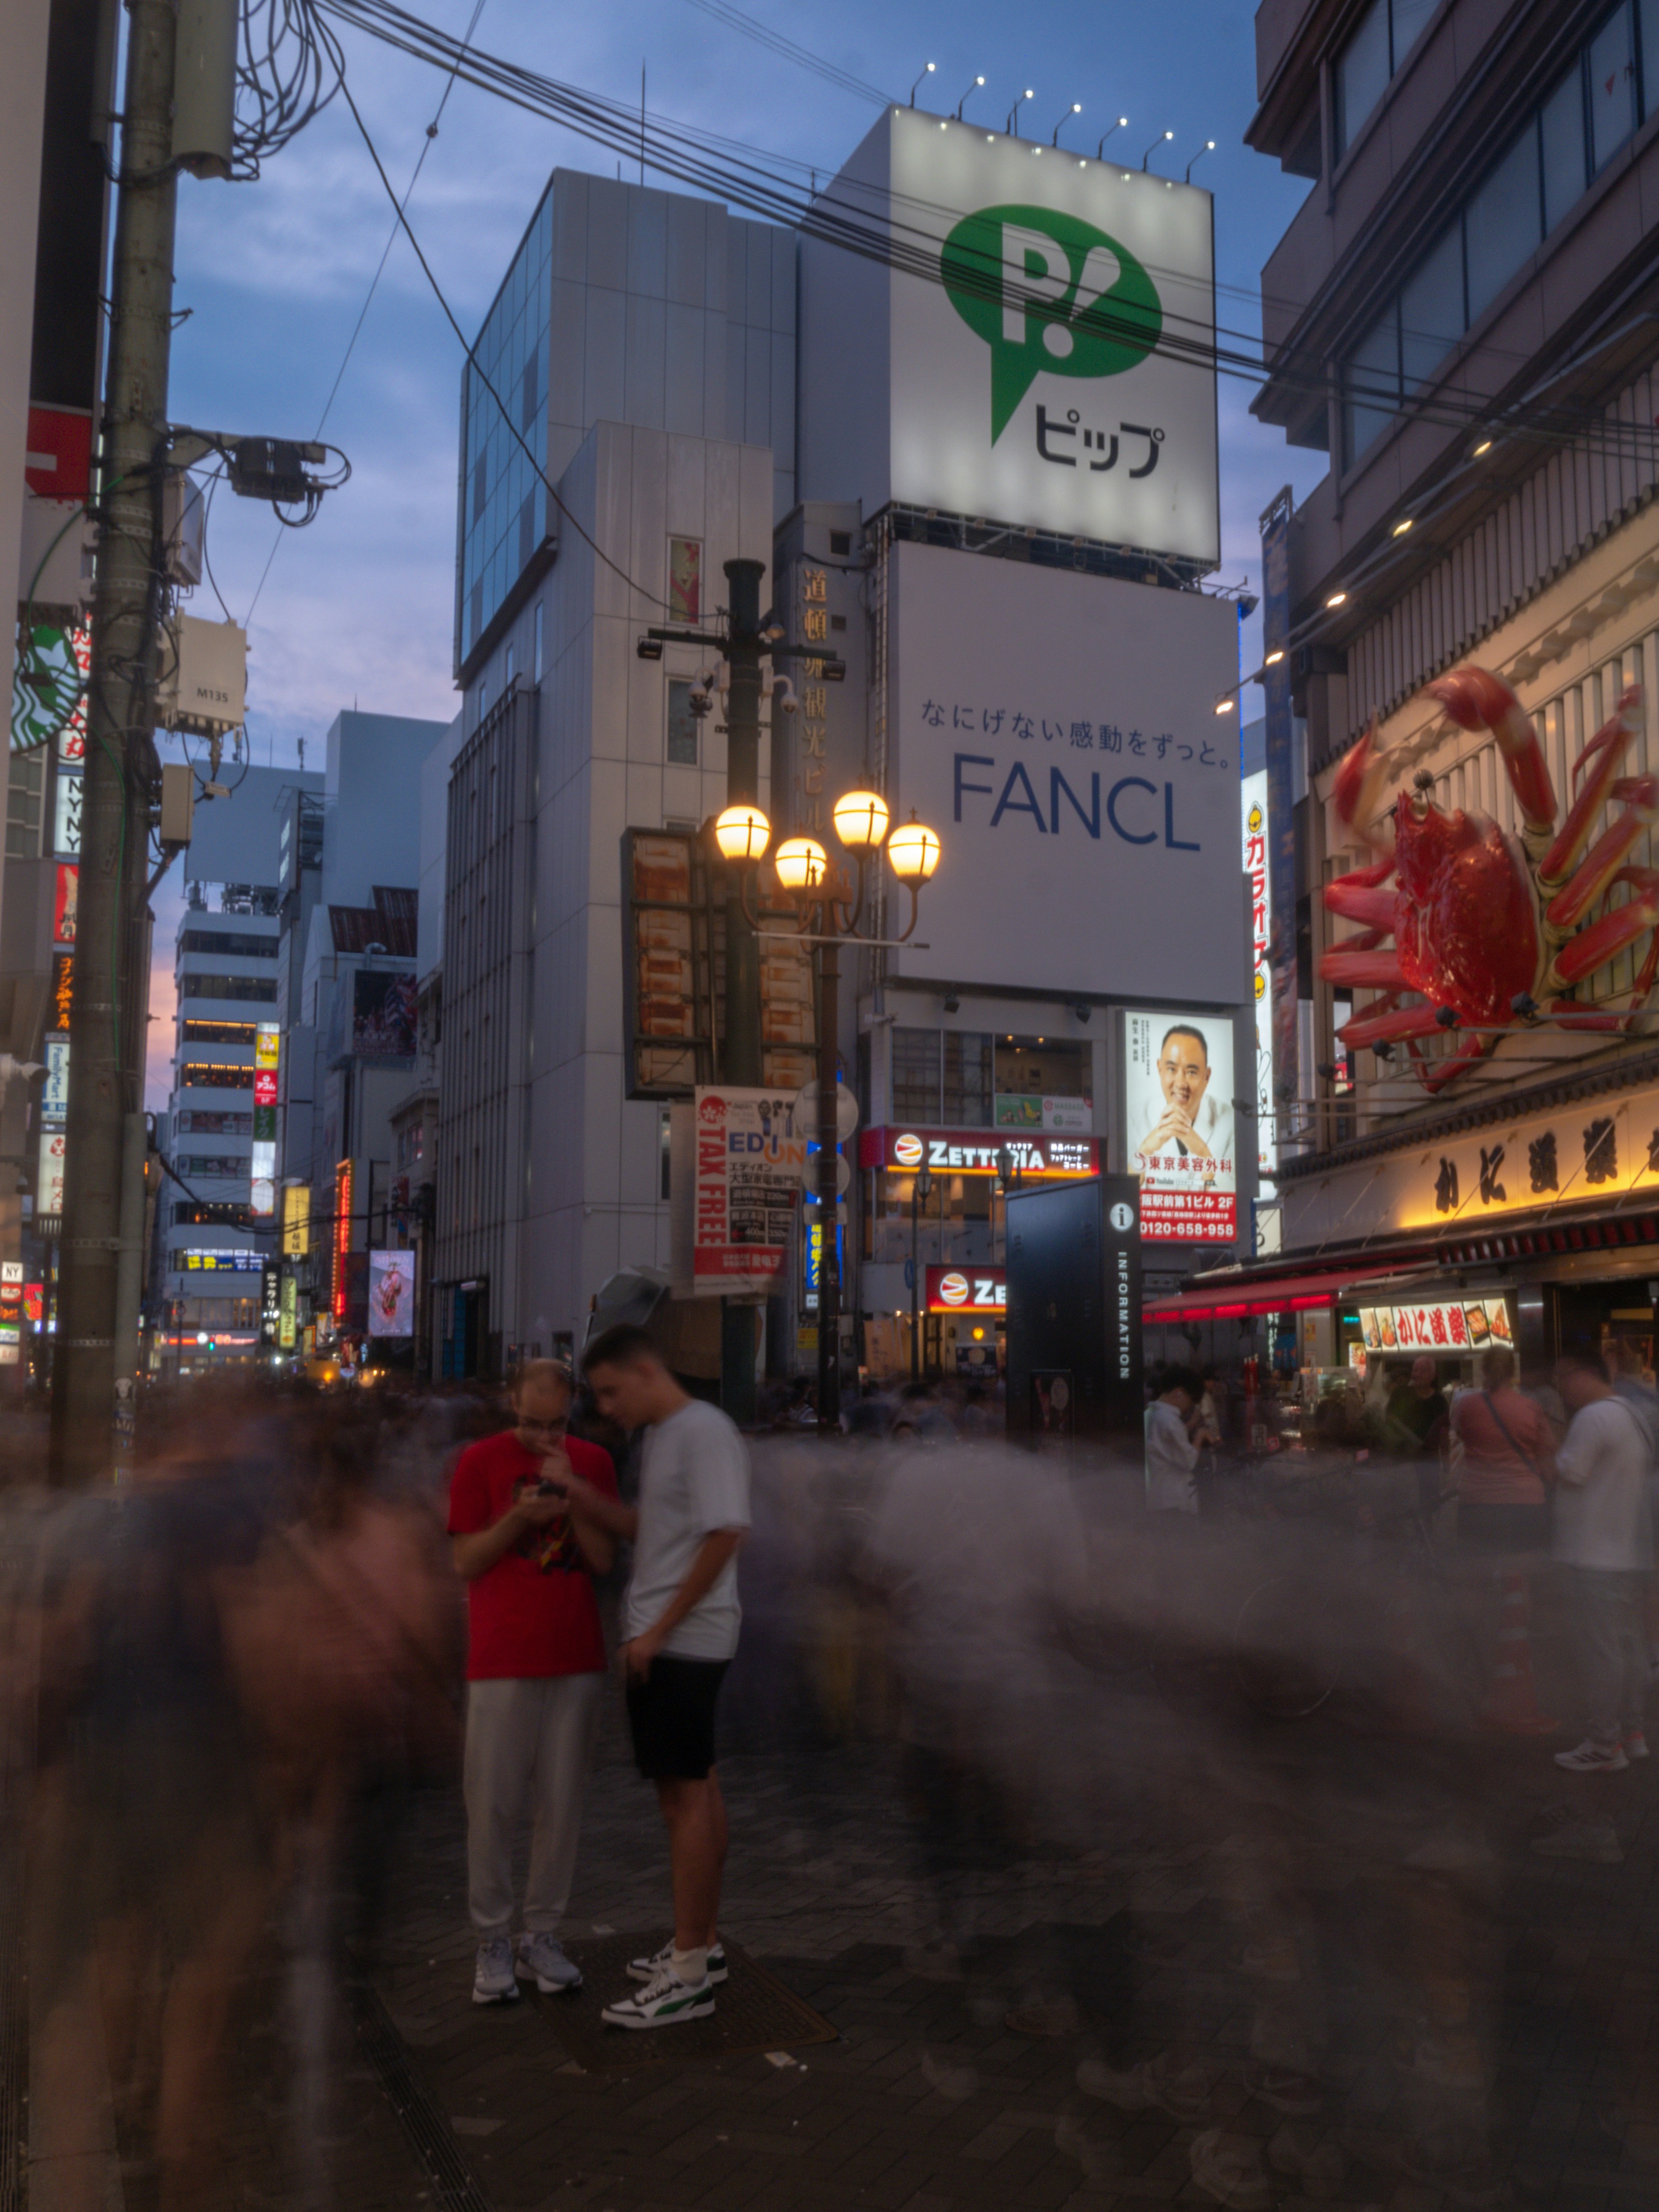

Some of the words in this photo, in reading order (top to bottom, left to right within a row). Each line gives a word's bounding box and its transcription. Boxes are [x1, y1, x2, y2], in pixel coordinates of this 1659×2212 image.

[1036, 402, 1165, 479] ピップ
[196, 686, 229, 704] M135
[921, 698, 1229, 770] なにげない感動をずっと。
[953, 752, 1201, 851] FANCL
[52, 1046, 63, 1099] FamilyMart
[257, 1082, 276, 1090] アコム
[259, 1107, 269, 1137] レイク
[699, 1125, 726, 1176] TAX
[728, 1132, 804, 1164] EDION
[1148, 1155, 1232, 1173] 東京美容外科
[730, 1162, 772, 1171] エディオン
[699, 1184, 726, 1244] FREE
[1217, 1197, 1233, 1209] 2F
[1140, 1221, 1233, 1235] 0120-658-958
[1117, 1251, 1130, 1380] INFORMATION
